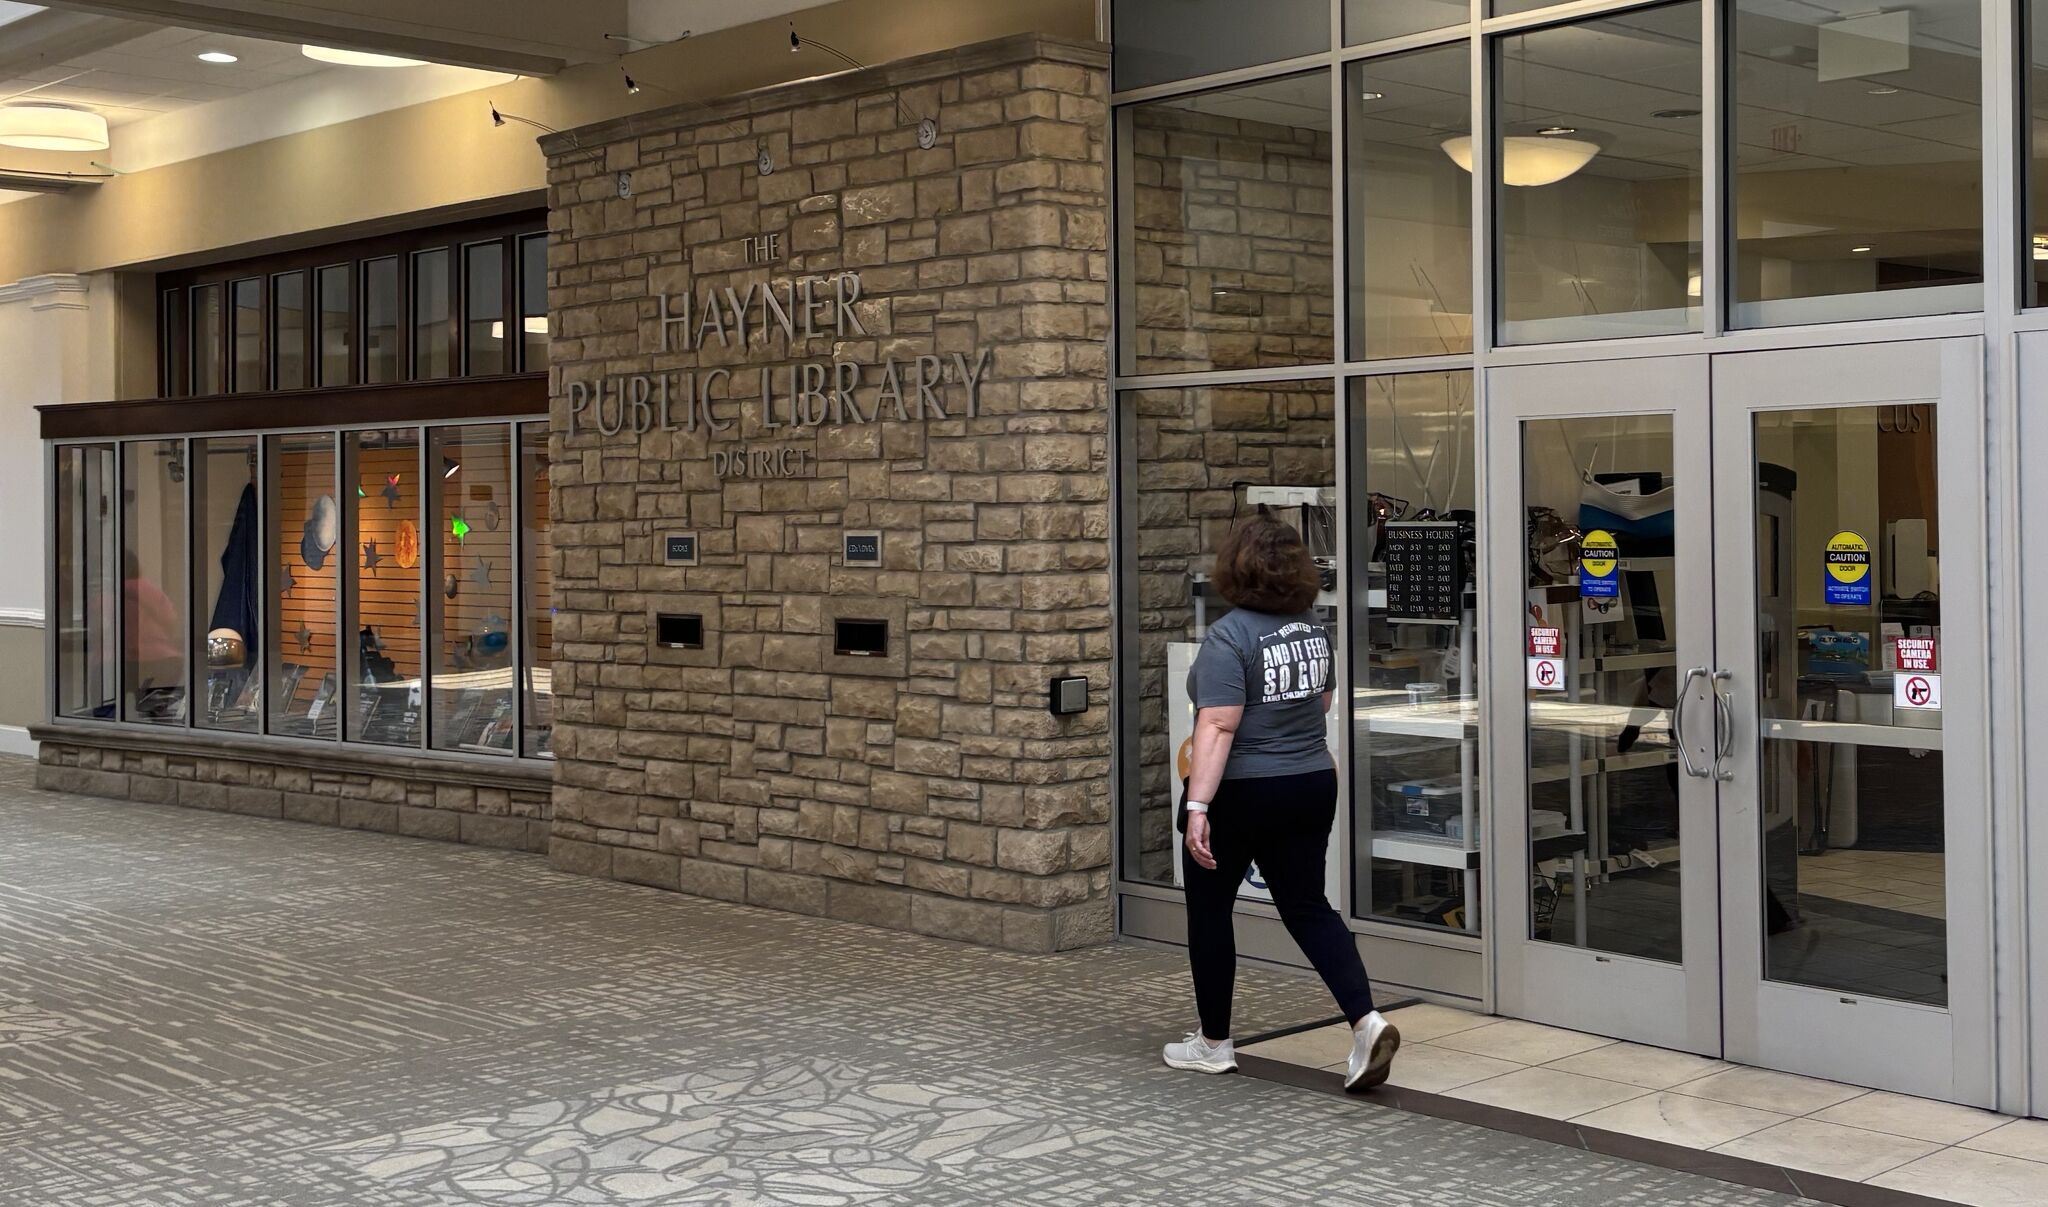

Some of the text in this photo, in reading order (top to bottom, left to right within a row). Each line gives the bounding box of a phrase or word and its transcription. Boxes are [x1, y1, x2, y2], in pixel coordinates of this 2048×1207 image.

[741, 233, 780, 263] THE
[659, 271, 866, 352] HAYNER
[568, 348, 992, 438] PUBLIC LIBRARY
[712, 448, 812, 479] DISTRICT
[1388, 530, 1454, 539] BUSINESS HOURS
[1390, 553, 1400, 561] TUE
[1584, 550, 1614, 558] CAUTION
[1829, 553, 1866, 562] CAUTION
[1389, 564, 1404, 572] WED
[1278, 622, 1311, 638] REUNITED
[1531, 627, 1559, 637] SECURITY
[1533, 636, 1557, 646] CAMERA
[1897, 639, 1934, 650] SECURITY
[1263, 643, 1290, 669] AND
[1290, 640, 1304, 662] IT
[1535, 645, 1542, 653] IN
[1900, 648, 1932, 659] CAMERA
[1903, 658, 1930, 669] IN USE.
[1264, 664, 1291, 695] SO
